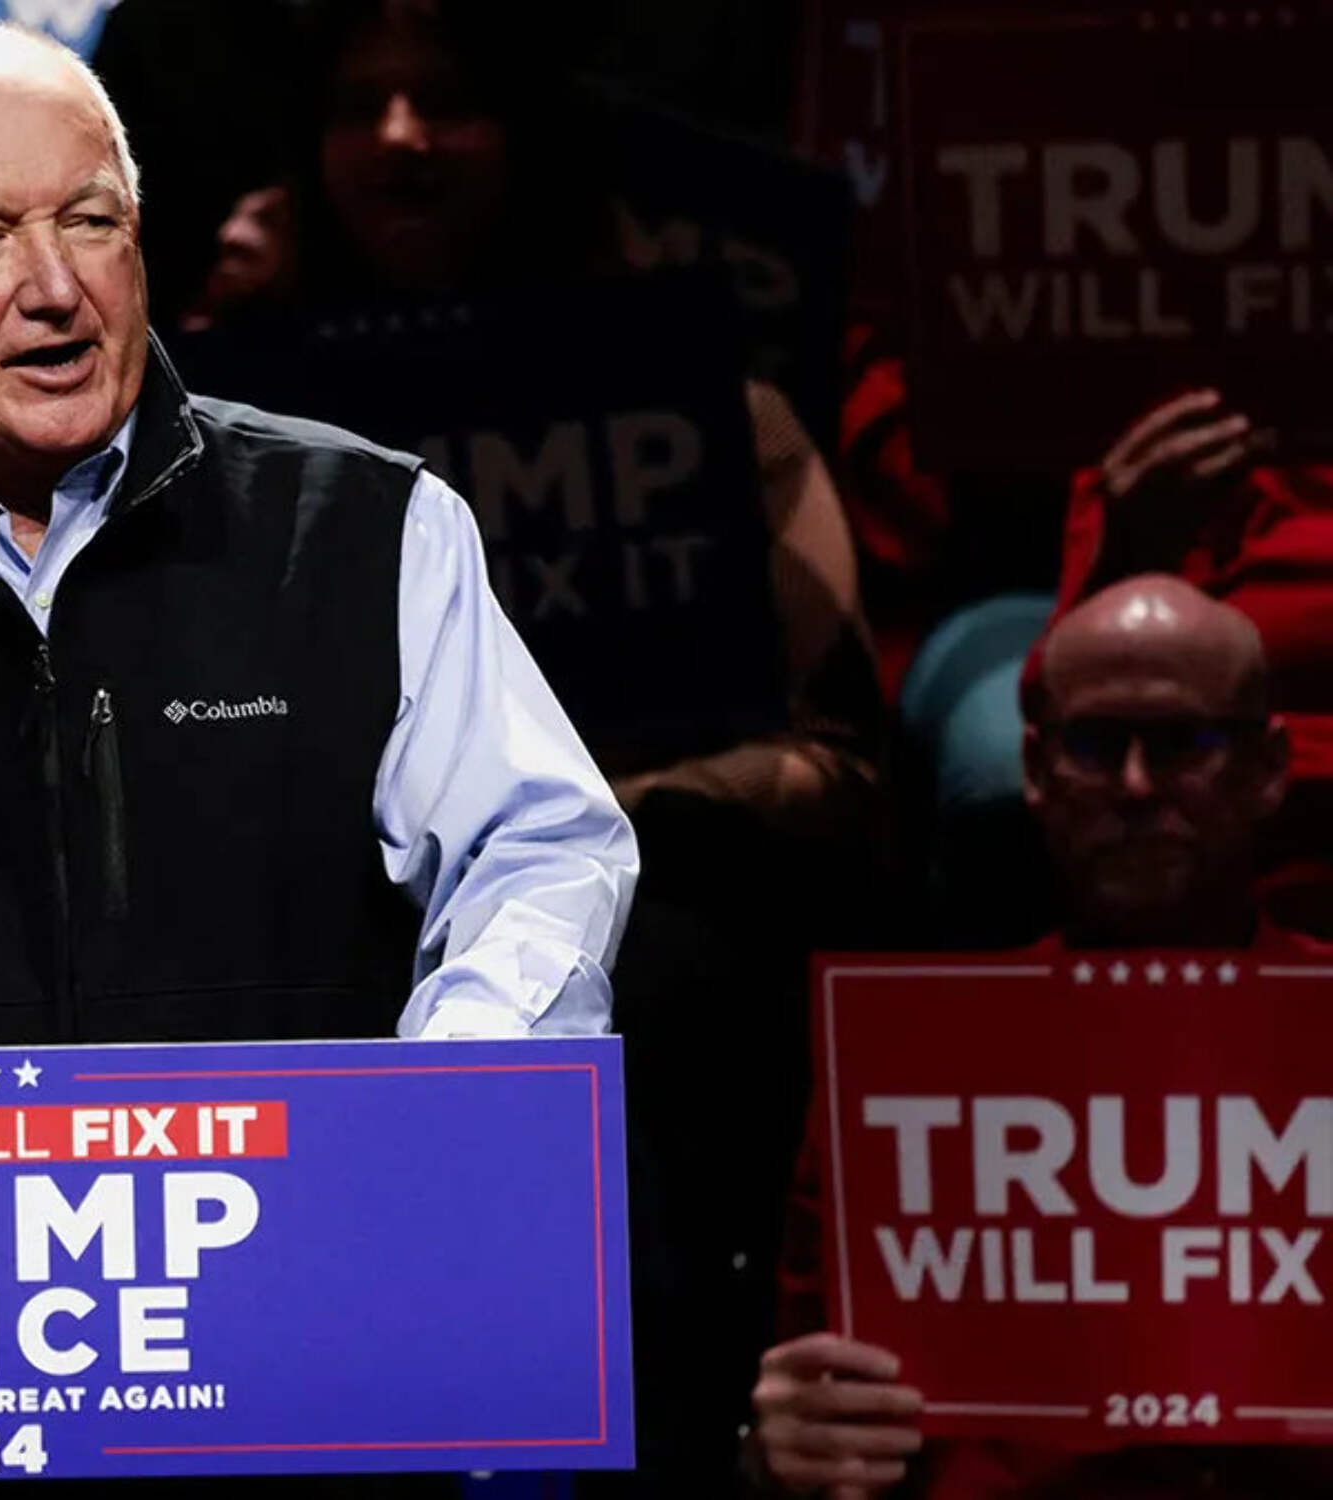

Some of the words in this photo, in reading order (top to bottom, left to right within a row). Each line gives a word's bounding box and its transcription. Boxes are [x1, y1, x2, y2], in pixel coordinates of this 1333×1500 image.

[948, 266, 1192, 343] WILL
[1225, 263, 1333, 334] FI
[621, 532, 718, 610] IT
[190, 695, 287, 720] Columbia
[71, 1107, 177, 1158] FIX
[197, 1106, 258, 1154] IT
[862, 1093, 1333, 1219] TRUM
[873, 1225, 1130, 1305] WILL
[1159, 1225, 1324, 1306] FIX
[99, 1384, 226, 1411] AGAIN!
[1103, 1391, 1222, 1428] 2024
